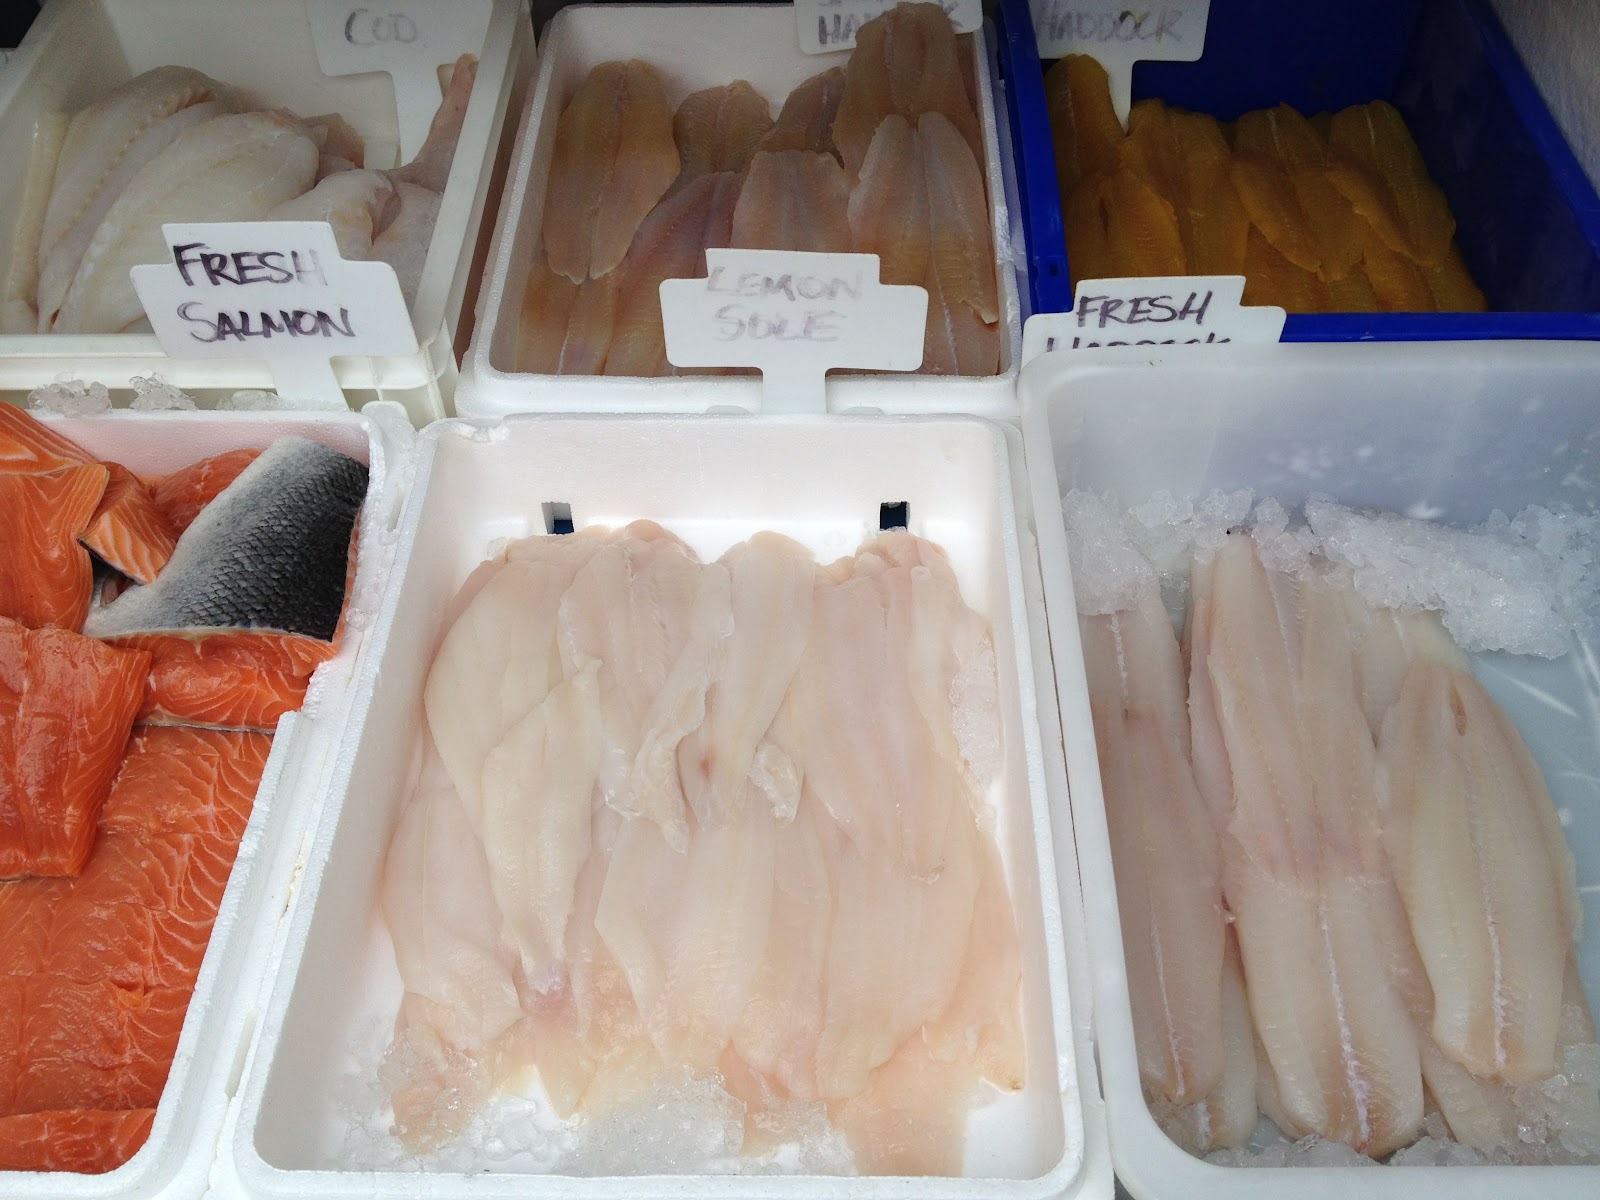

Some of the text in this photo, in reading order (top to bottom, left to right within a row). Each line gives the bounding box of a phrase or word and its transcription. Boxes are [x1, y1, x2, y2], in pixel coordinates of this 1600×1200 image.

[344, 8, 418, 46] COD
[172, 242, 329, 287] FRESH
[706, 266, 864, 302] LEMON
[176, 301, 357, 343] SALMON
[713, 303, 847, 342] SOLE
[1076, 290, 1213, 329] FRESH
